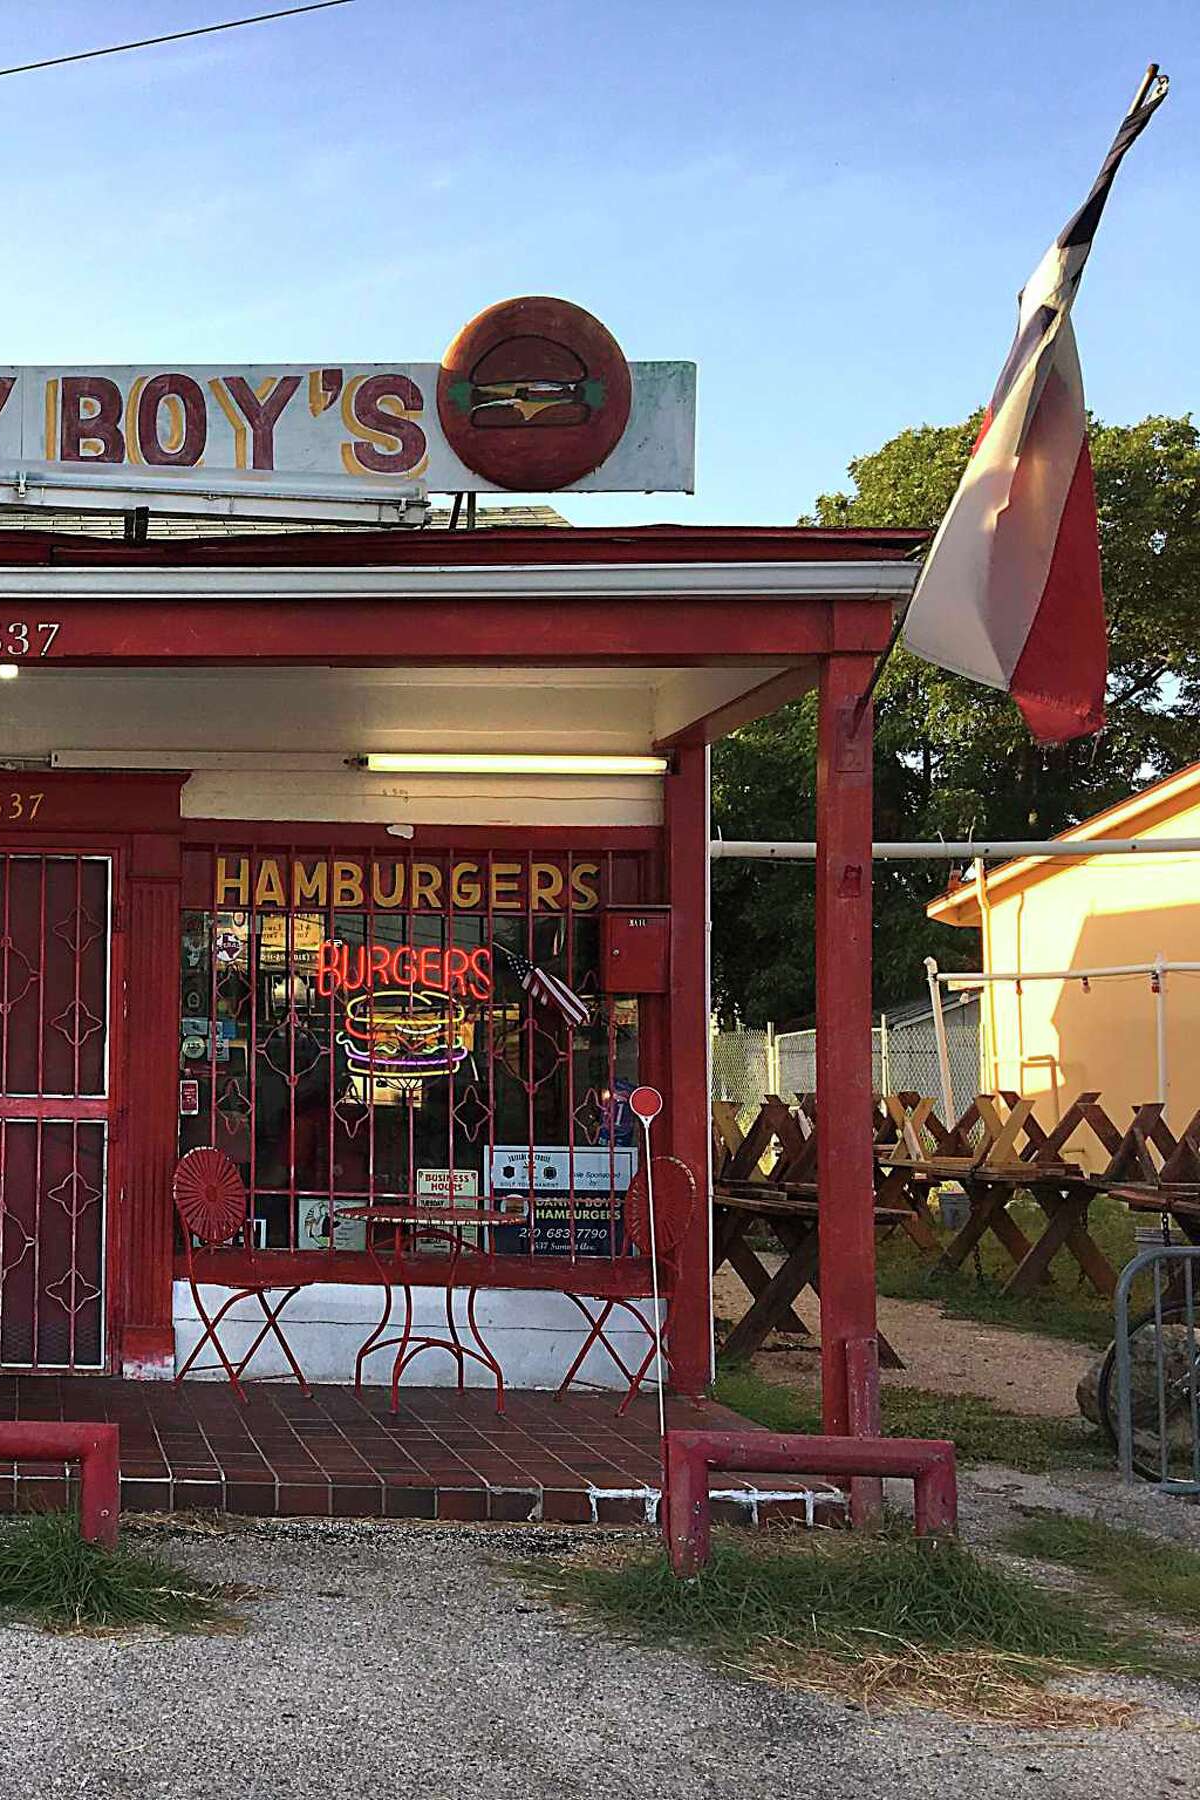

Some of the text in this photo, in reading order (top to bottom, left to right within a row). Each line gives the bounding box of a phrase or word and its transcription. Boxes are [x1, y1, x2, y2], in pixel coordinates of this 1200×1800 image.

[46, 373, 429, 477] BOY'S
[215, 857, 601, 911] HAMBURGERS
[318, 941, 492, 1000] BURGERS
[576, 1228, 608, 1240] 7790
